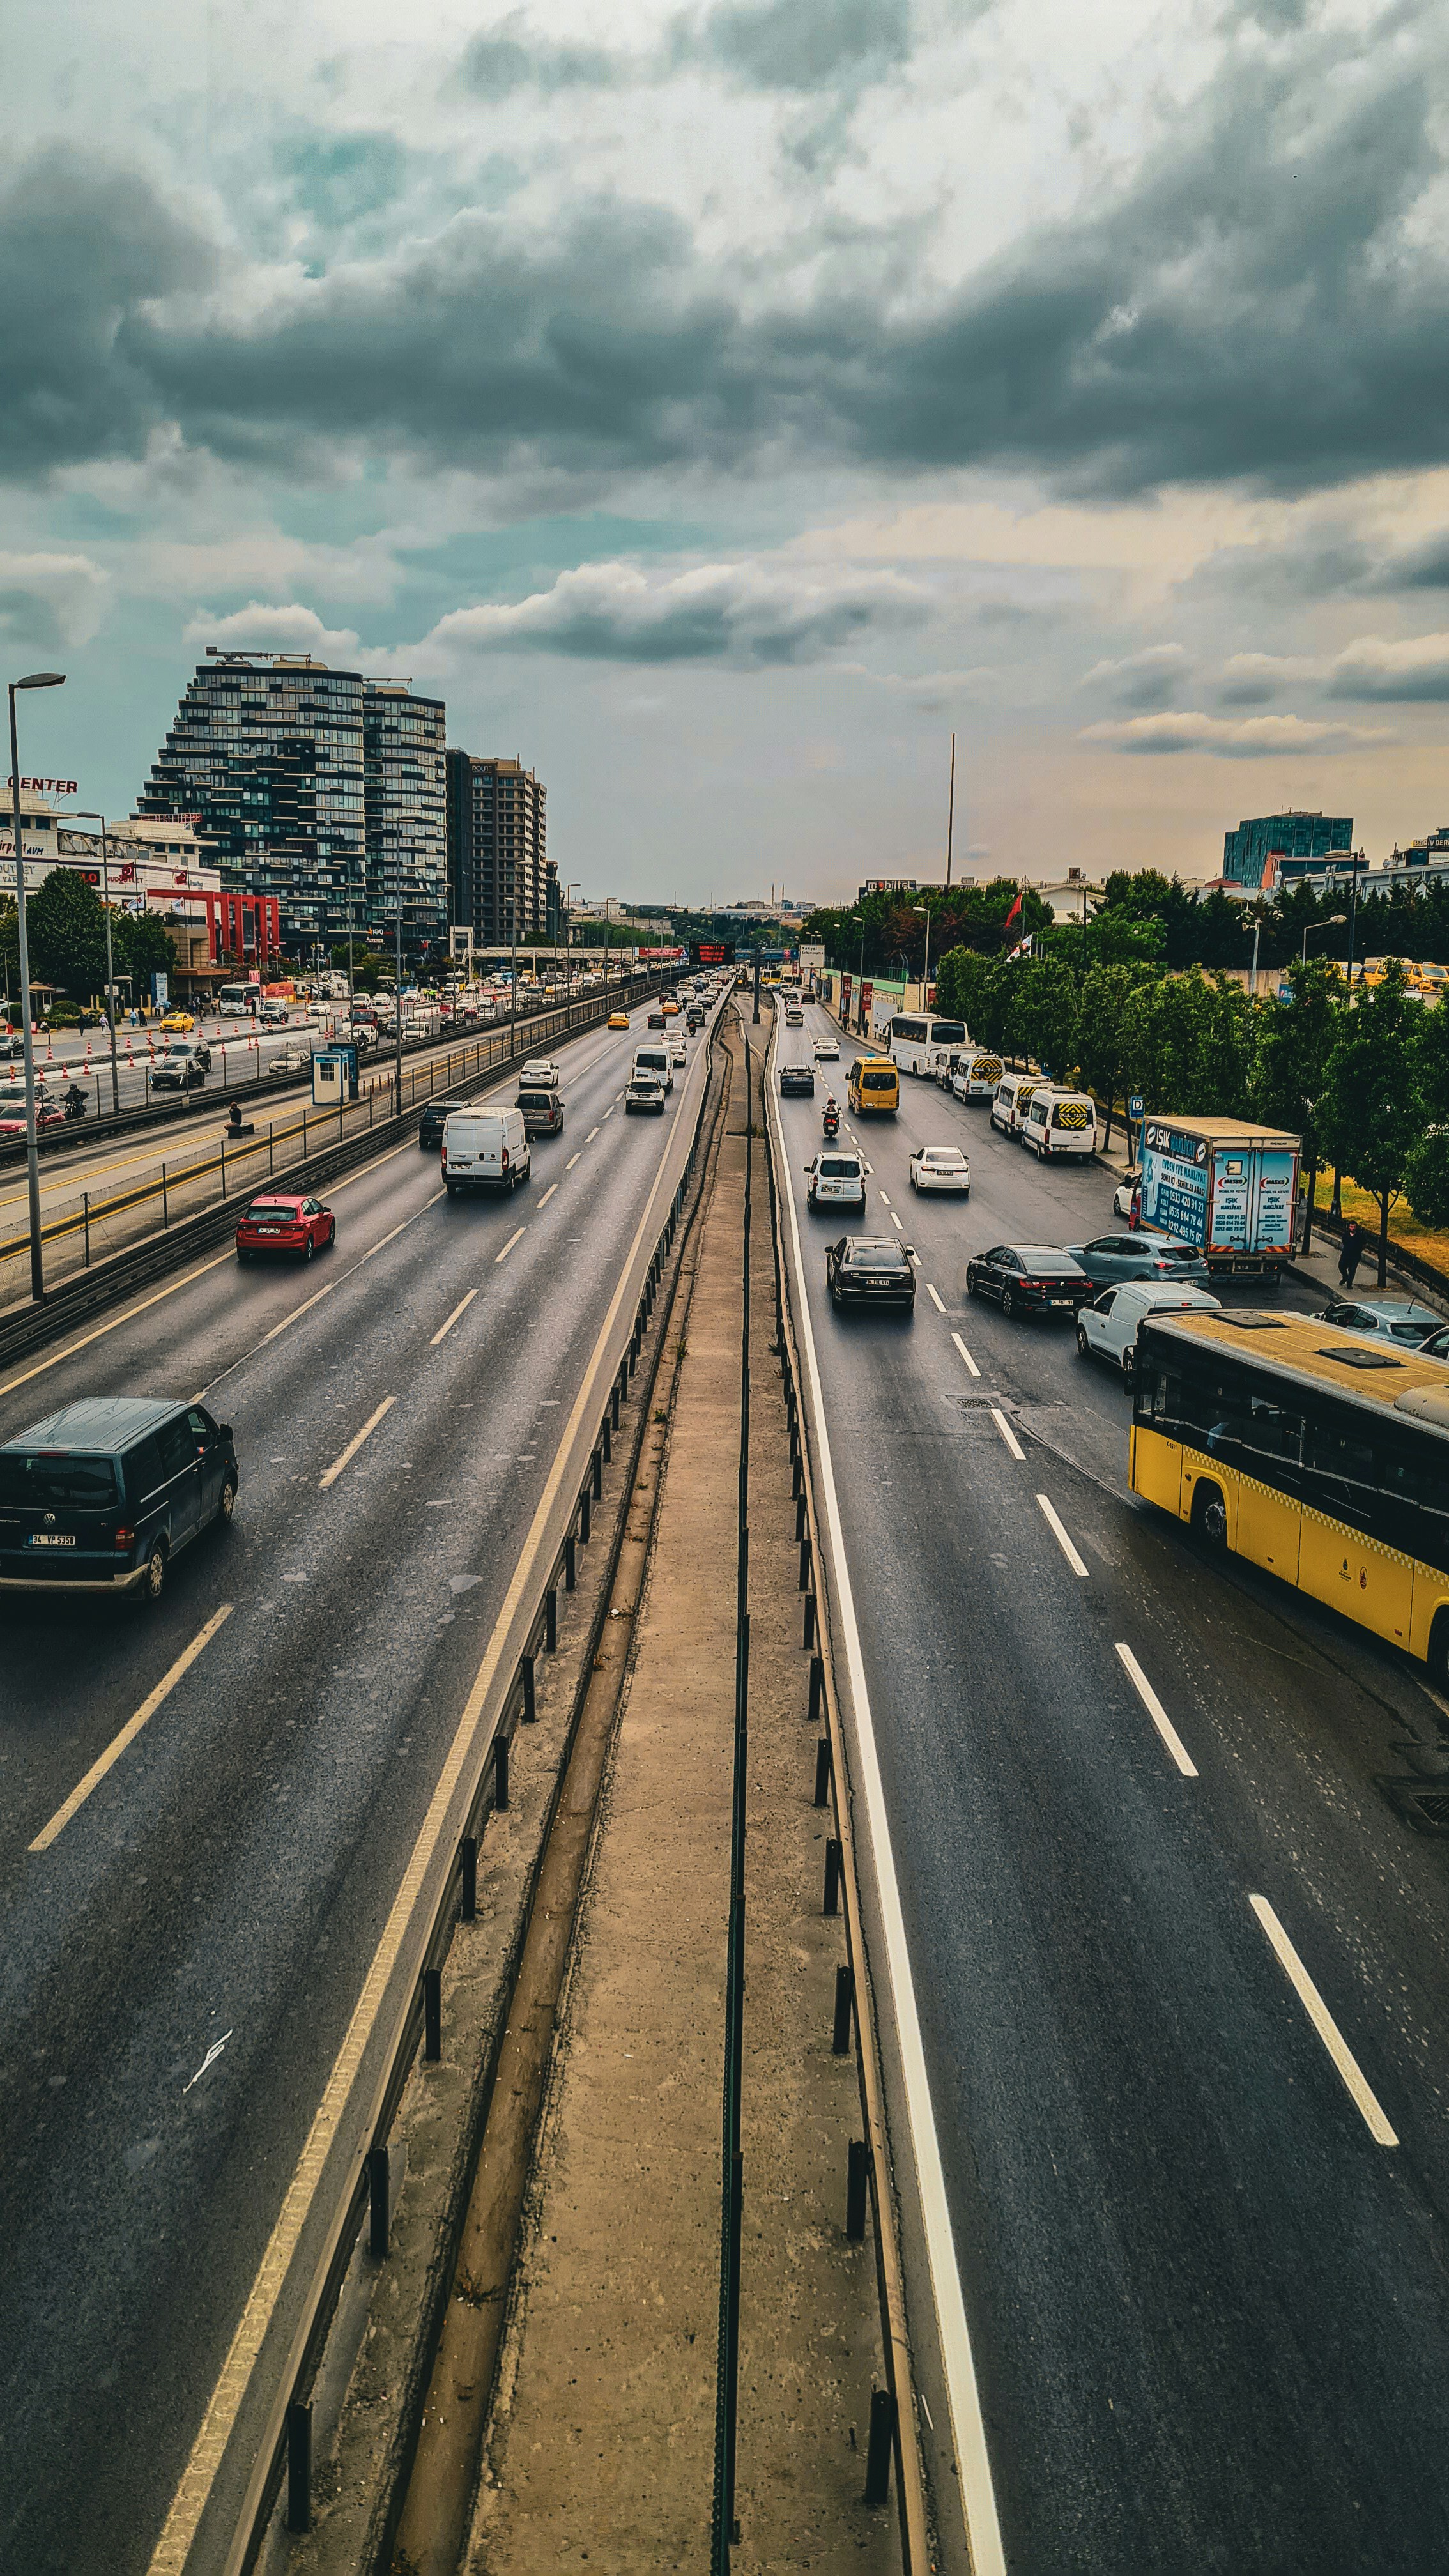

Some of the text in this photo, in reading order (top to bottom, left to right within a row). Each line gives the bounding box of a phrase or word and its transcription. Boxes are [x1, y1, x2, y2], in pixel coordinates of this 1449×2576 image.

[8, 776, 78, 793] CENTER
[0, 864, 35, 875] UTET
[1134, 1100, 1142, 1109] D
[1156, 1128, 1171, 1151] IŞIK
[1162, 1158, 1176, 1173] EVDEN
[1170, 1190, 1204, 1214] 0533 420 91 23
[1169, 1205, 1180, 1219] 0535
[1180, 1209, 1190, 1223] 614
[1190, 1213, 1197, 1226] 78
[1197, 1216, 1203, 1229] 44
[1167, 1219, 1179, 1234] 0212
[1179, 1225, 1189, 1239] 495
[1189, 1229, 1195, 1241] 75
[1195, 1232, 1202, 1245] 07
[33, 1535, 42, 1544] 34
[47, 1536, 56, 1544] VP
